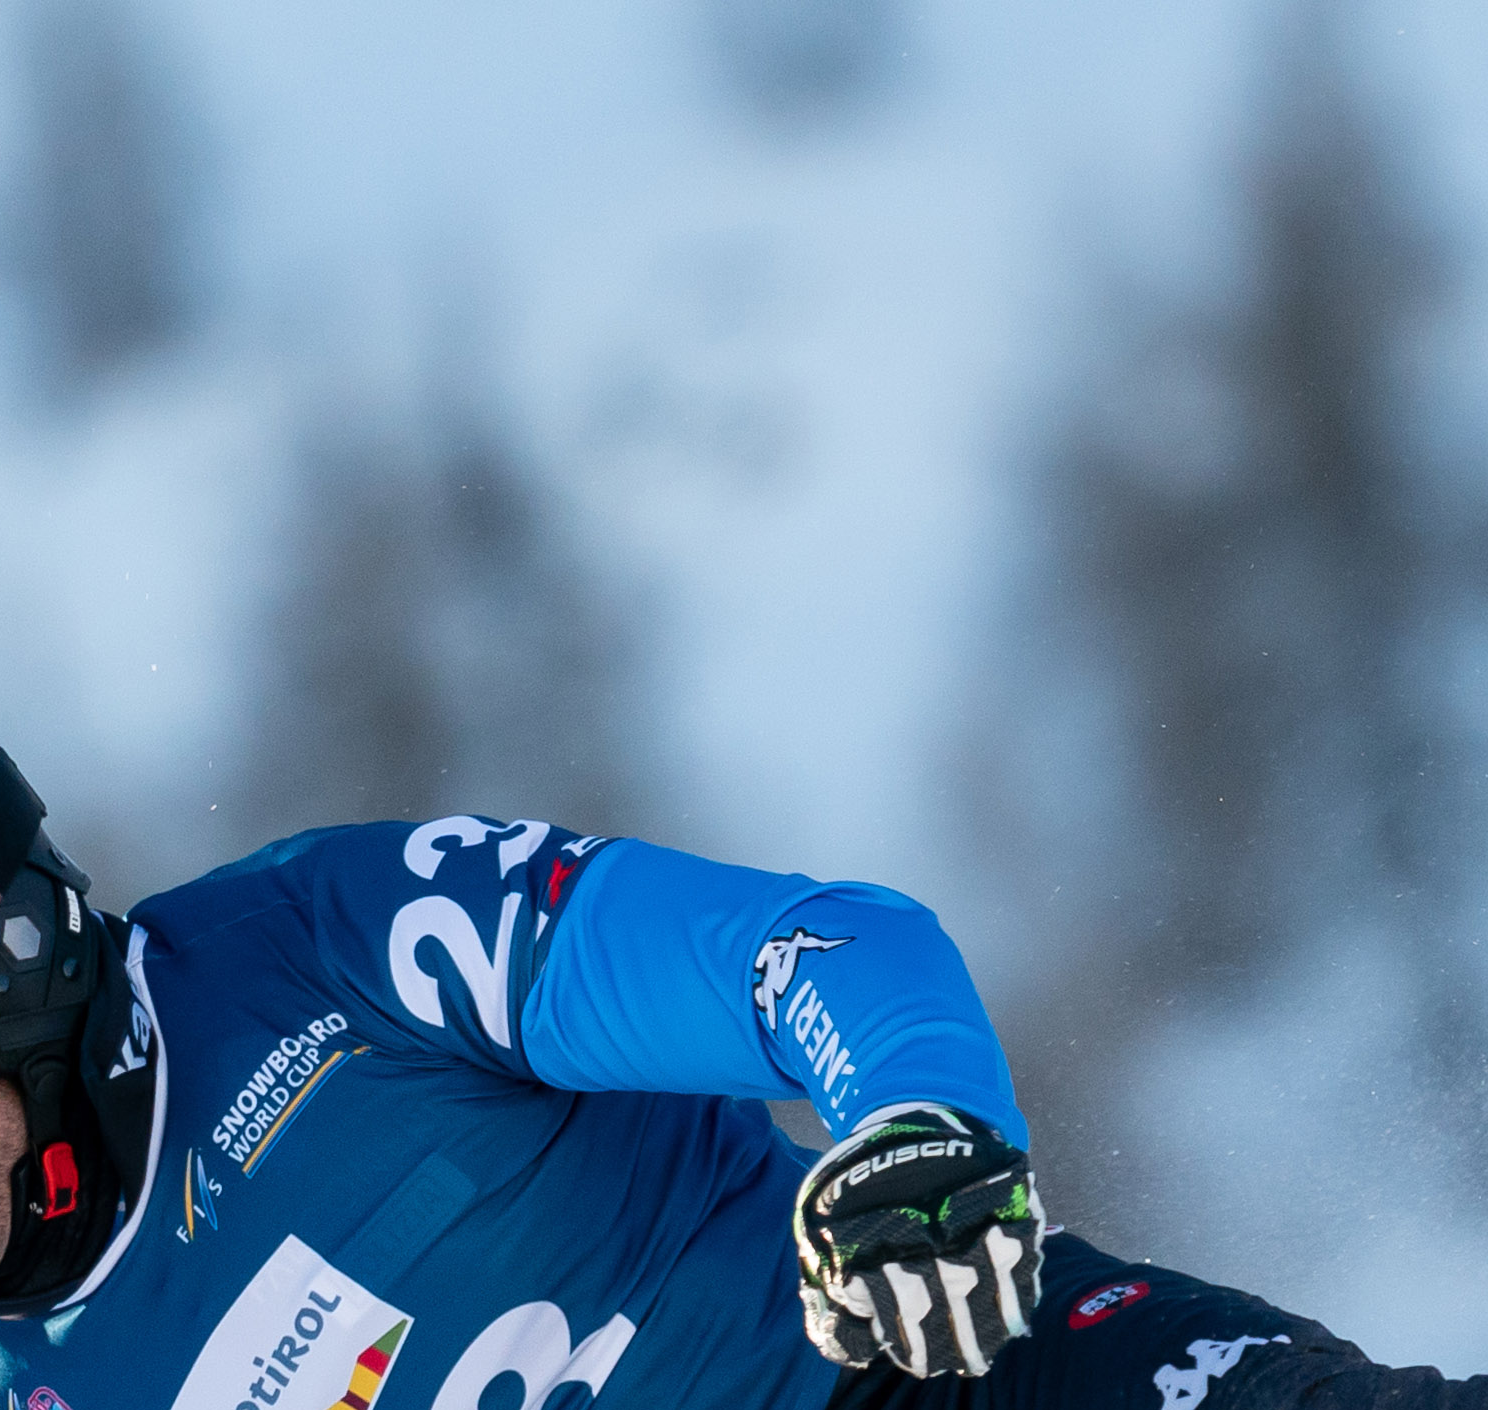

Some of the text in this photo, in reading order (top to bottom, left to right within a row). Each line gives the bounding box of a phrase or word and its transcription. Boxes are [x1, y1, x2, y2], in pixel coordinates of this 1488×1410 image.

[389, 816, 550, 1049] 23
[212, 1012, 349, 1152] SNOWBOARD
[227, 1046, 321, 1164] WORLD CUP
[832, 1139, 974, 1200] reusch
